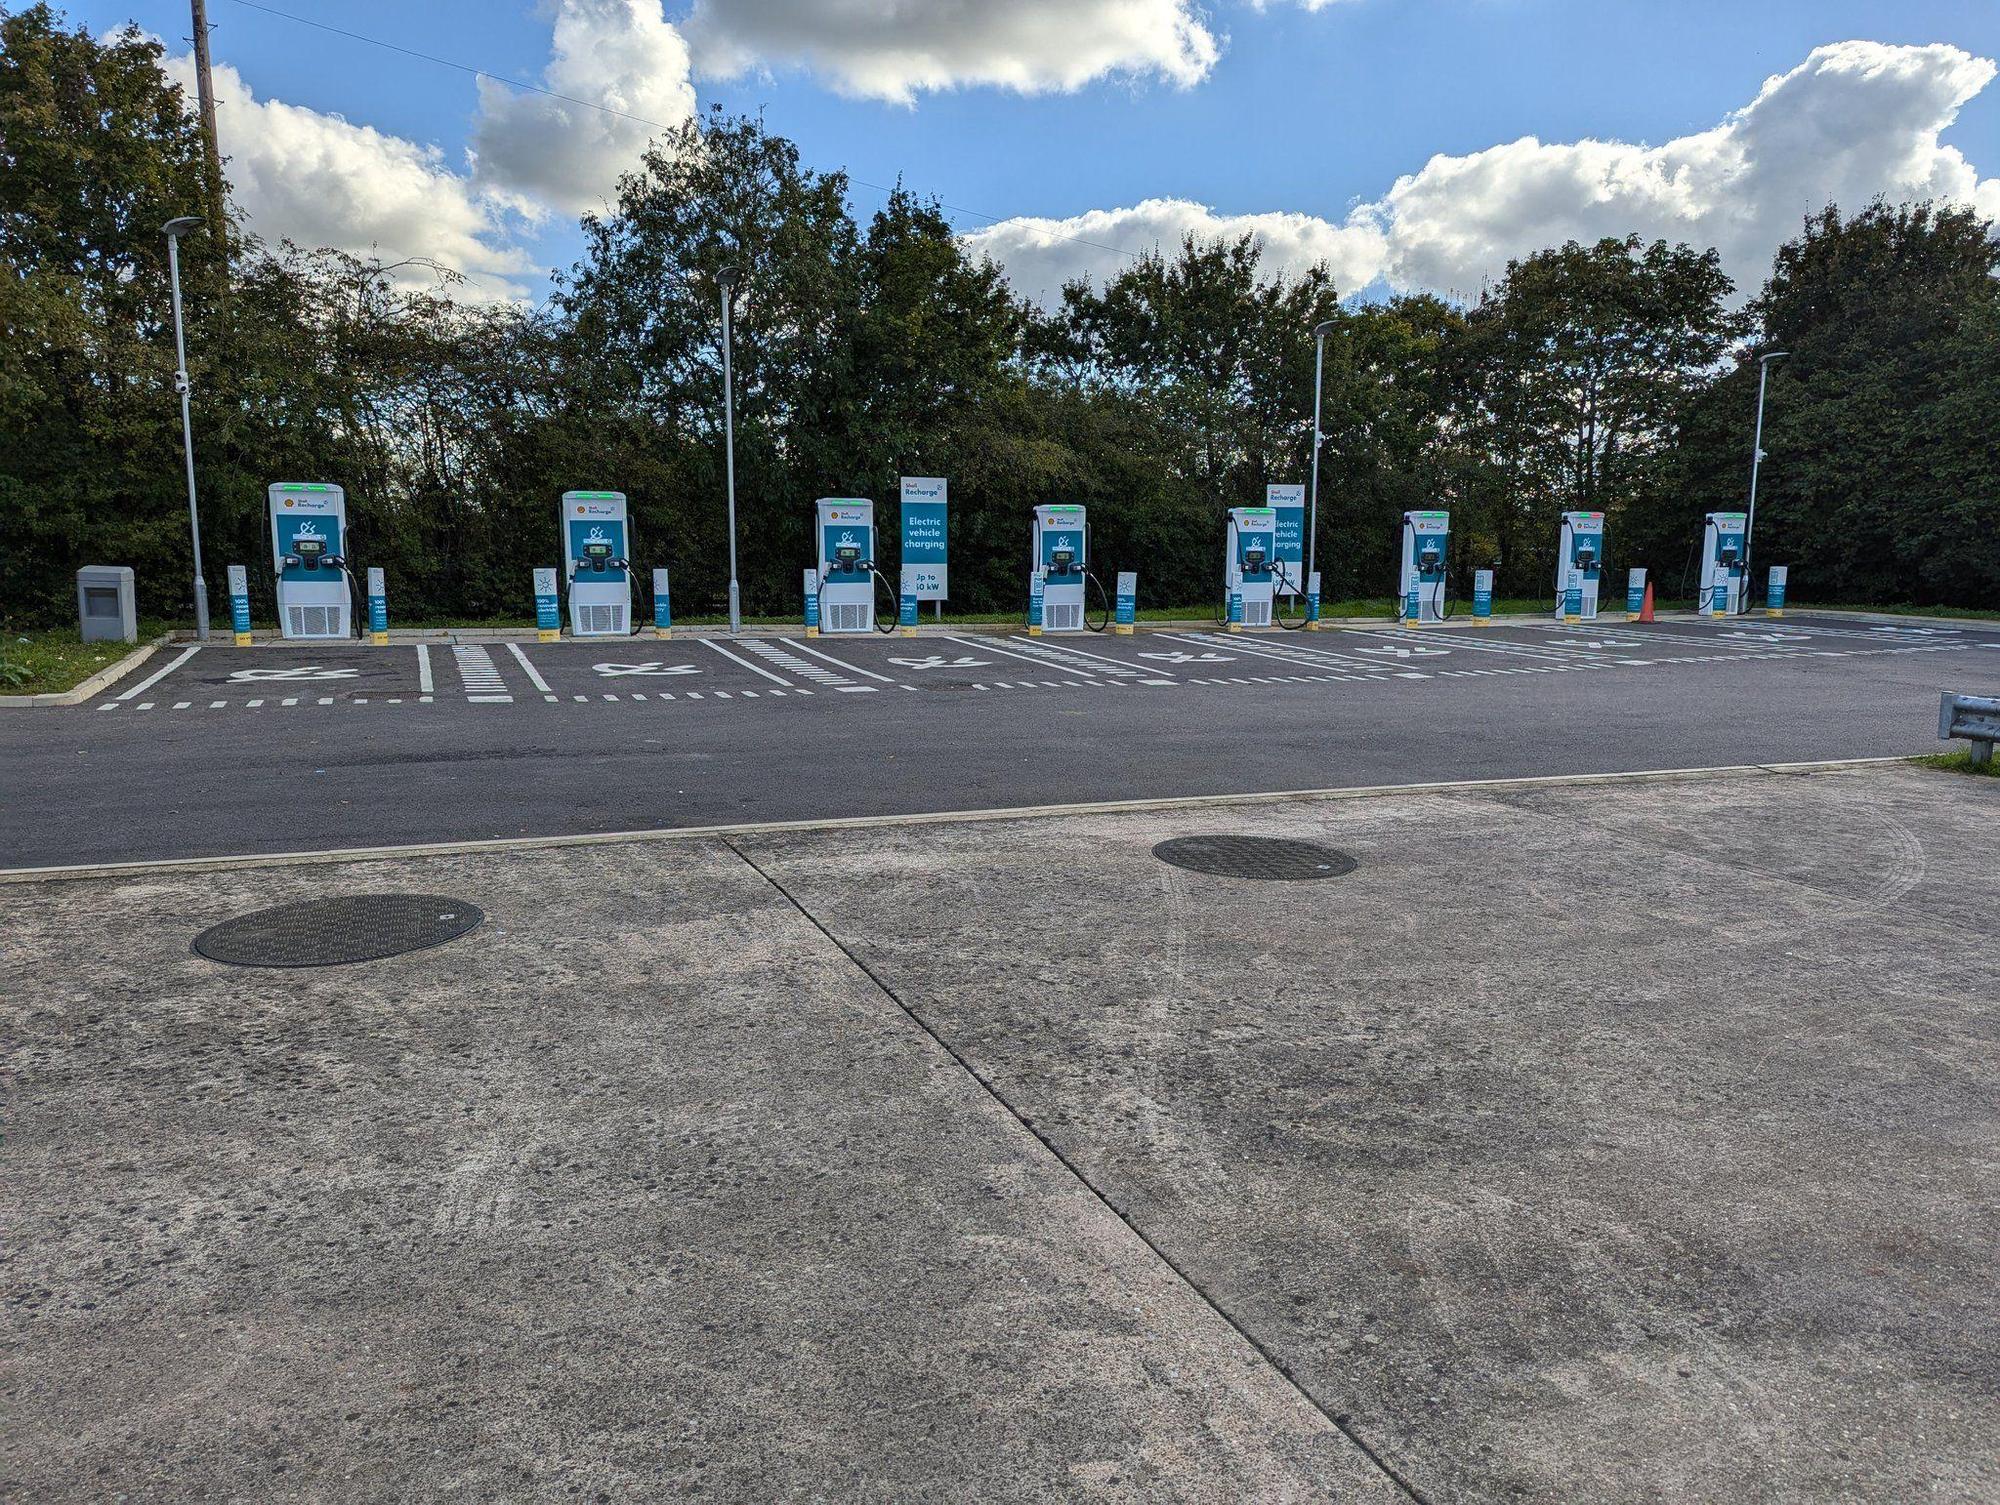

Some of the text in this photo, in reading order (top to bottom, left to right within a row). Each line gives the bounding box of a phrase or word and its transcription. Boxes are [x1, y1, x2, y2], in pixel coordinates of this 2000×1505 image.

[905, 489, 938, 497] Recharge
[909, 516, 941, 526] Electric
[1275, 520, 1298, 528] lectric
[909, 528, 940, 537] vehicle
[1275, 529, 1298, 538] ehicle
[904, 540, 945, 550] charging
[1274, 540, 1301, 550] arging
[926, 583, 940, 591] kW
